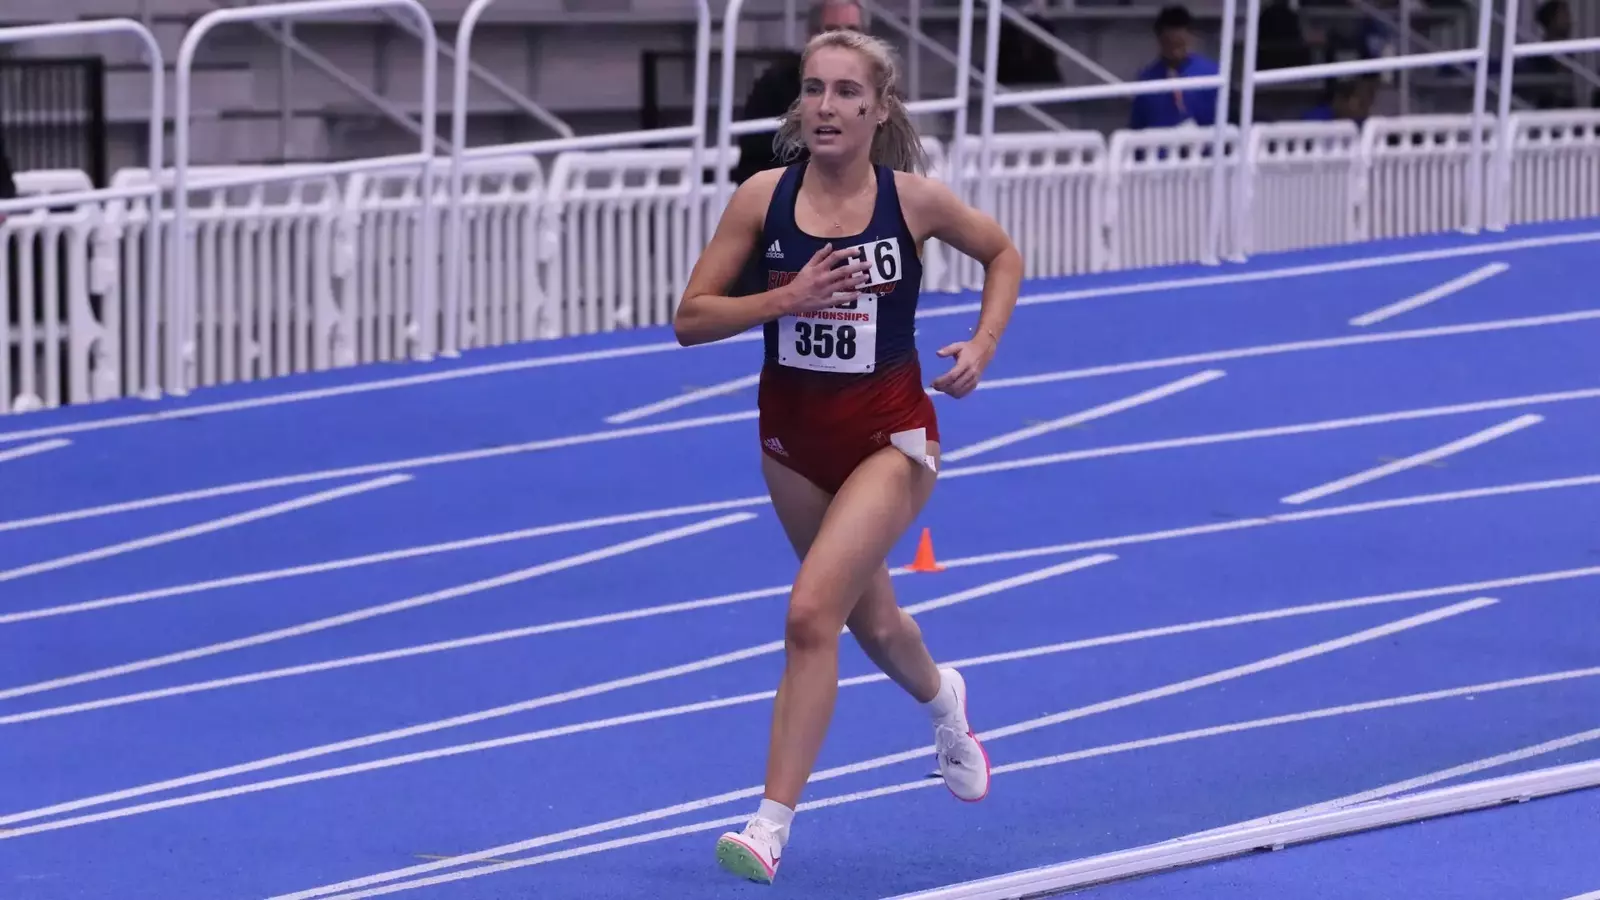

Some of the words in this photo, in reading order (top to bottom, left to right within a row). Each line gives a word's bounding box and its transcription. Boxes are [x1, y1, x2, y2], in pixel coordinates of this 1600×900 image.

[765, 251, 785, 259] adidas
[788, 310, 869, 321] AMPIONSHIPS
[795, 321, 856, 360] 358
